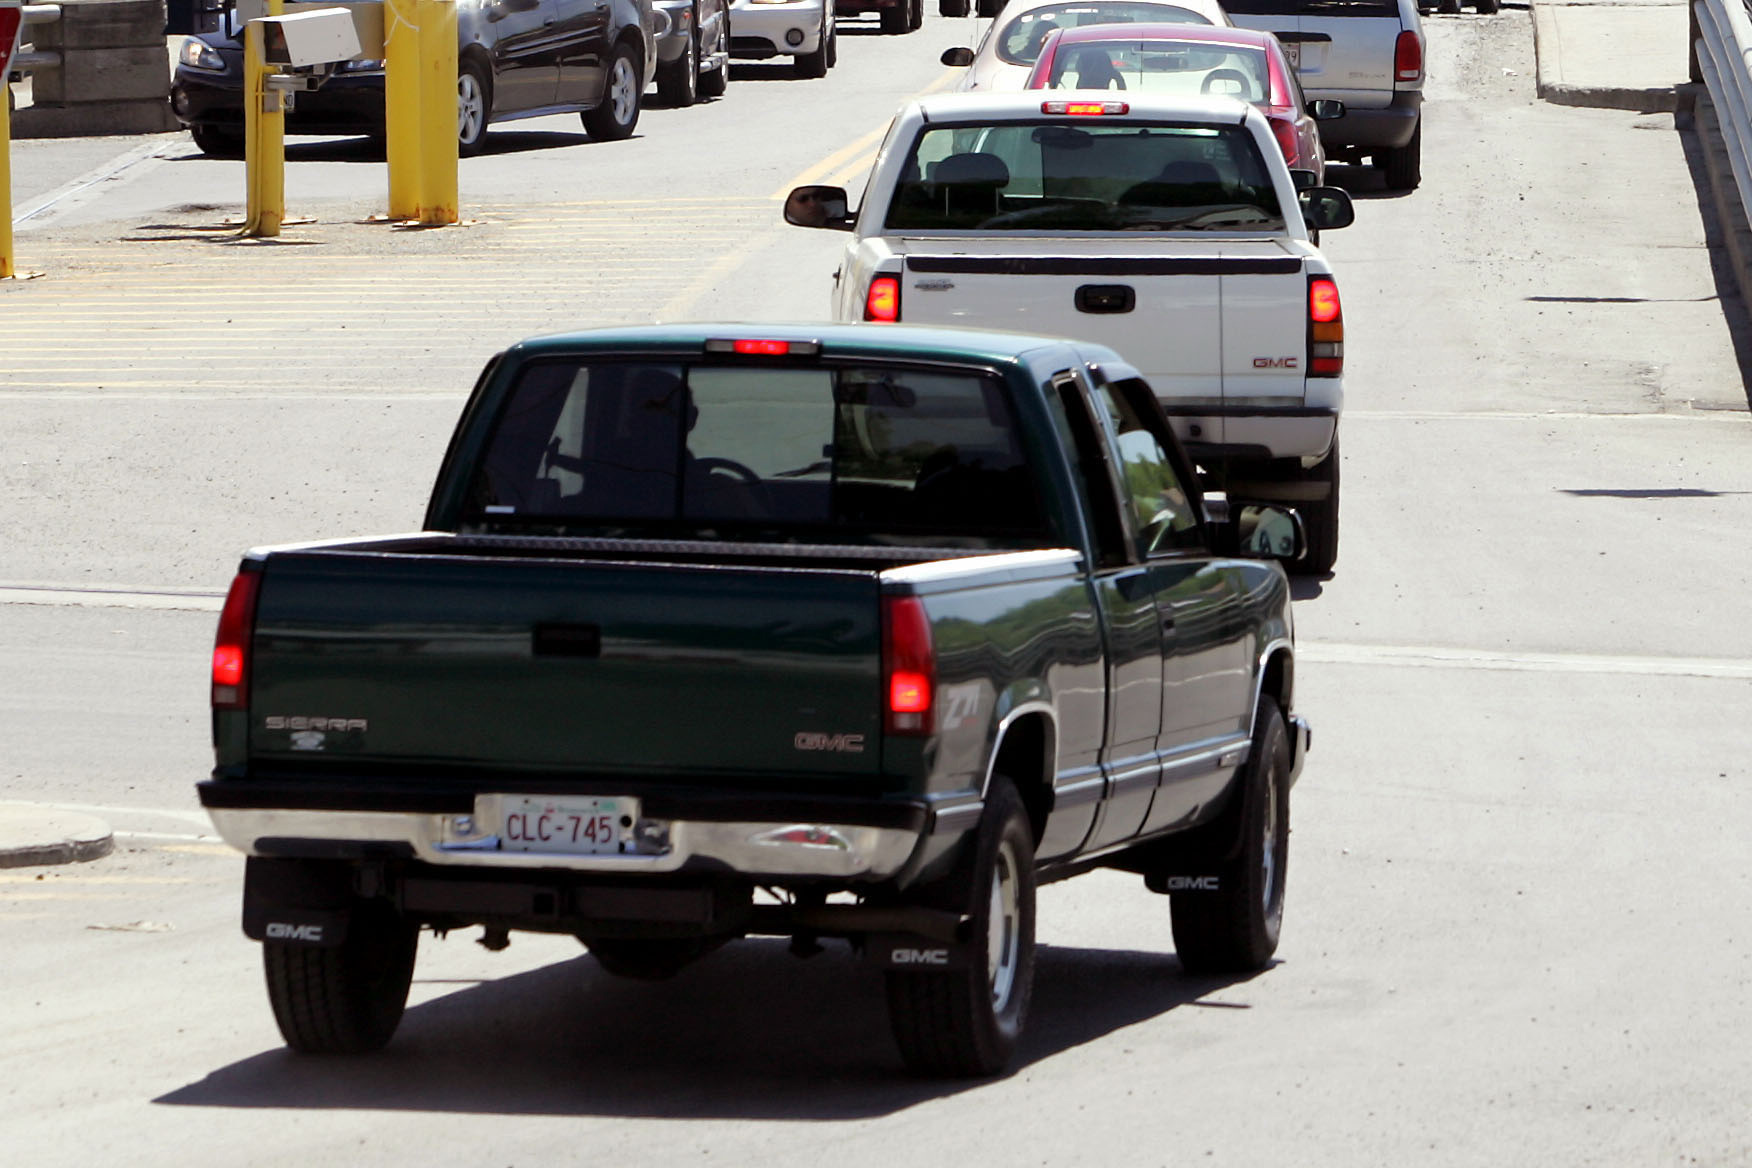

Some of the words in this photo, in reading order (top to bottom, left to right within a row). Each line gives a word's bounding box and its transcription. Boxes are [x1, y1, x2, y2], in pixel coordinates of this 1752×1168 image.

[1252, 357, 1299, 370] GMC
[265, 716, 367, 732] SIERRA
[794, 732, 865, 753] GMC
[506, 813, 613, 844] CLC-745
[1167, 876, 1220, 891] GMC
[265, 922, 323, 941] GMC
[891, 948, 949, 964] GMC
